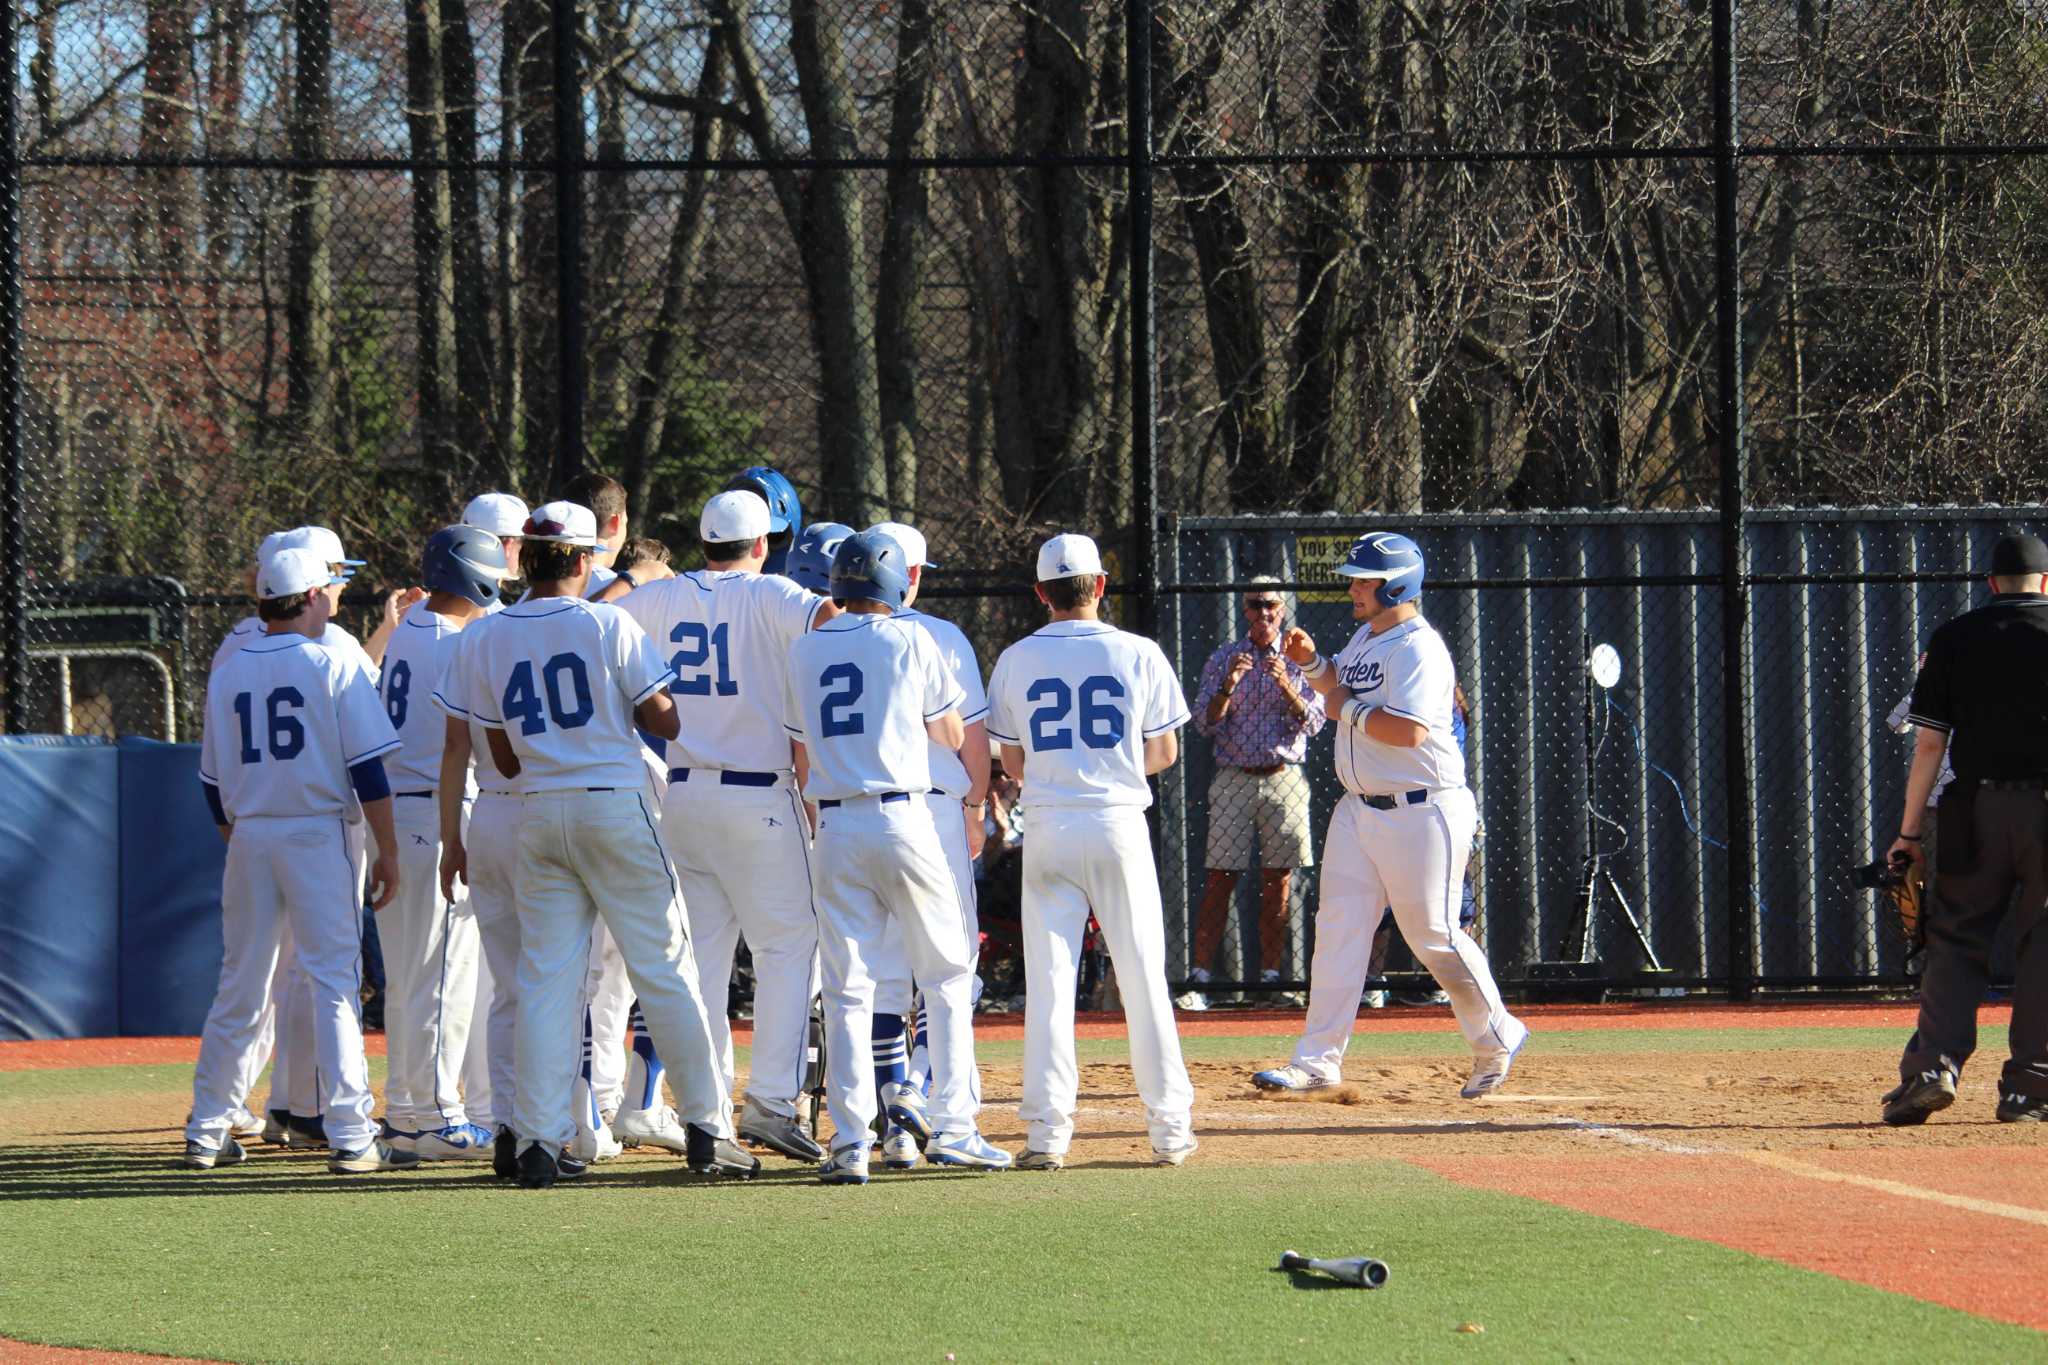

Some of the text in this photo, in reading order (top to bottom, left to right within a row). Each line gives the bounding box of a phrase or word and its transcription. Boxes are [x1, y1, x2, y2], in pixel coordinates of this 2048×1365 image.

[1300, 541, 1326, 557] YOU
[377, 655, 411, 730] 8
[502, 652, 595, 737] 40
[669, 621, 739, 697] 21
[233, 686, 305, 765] 16
[820, 662, 865, 738] 2
[1026, 675, 1125, 753] 26
